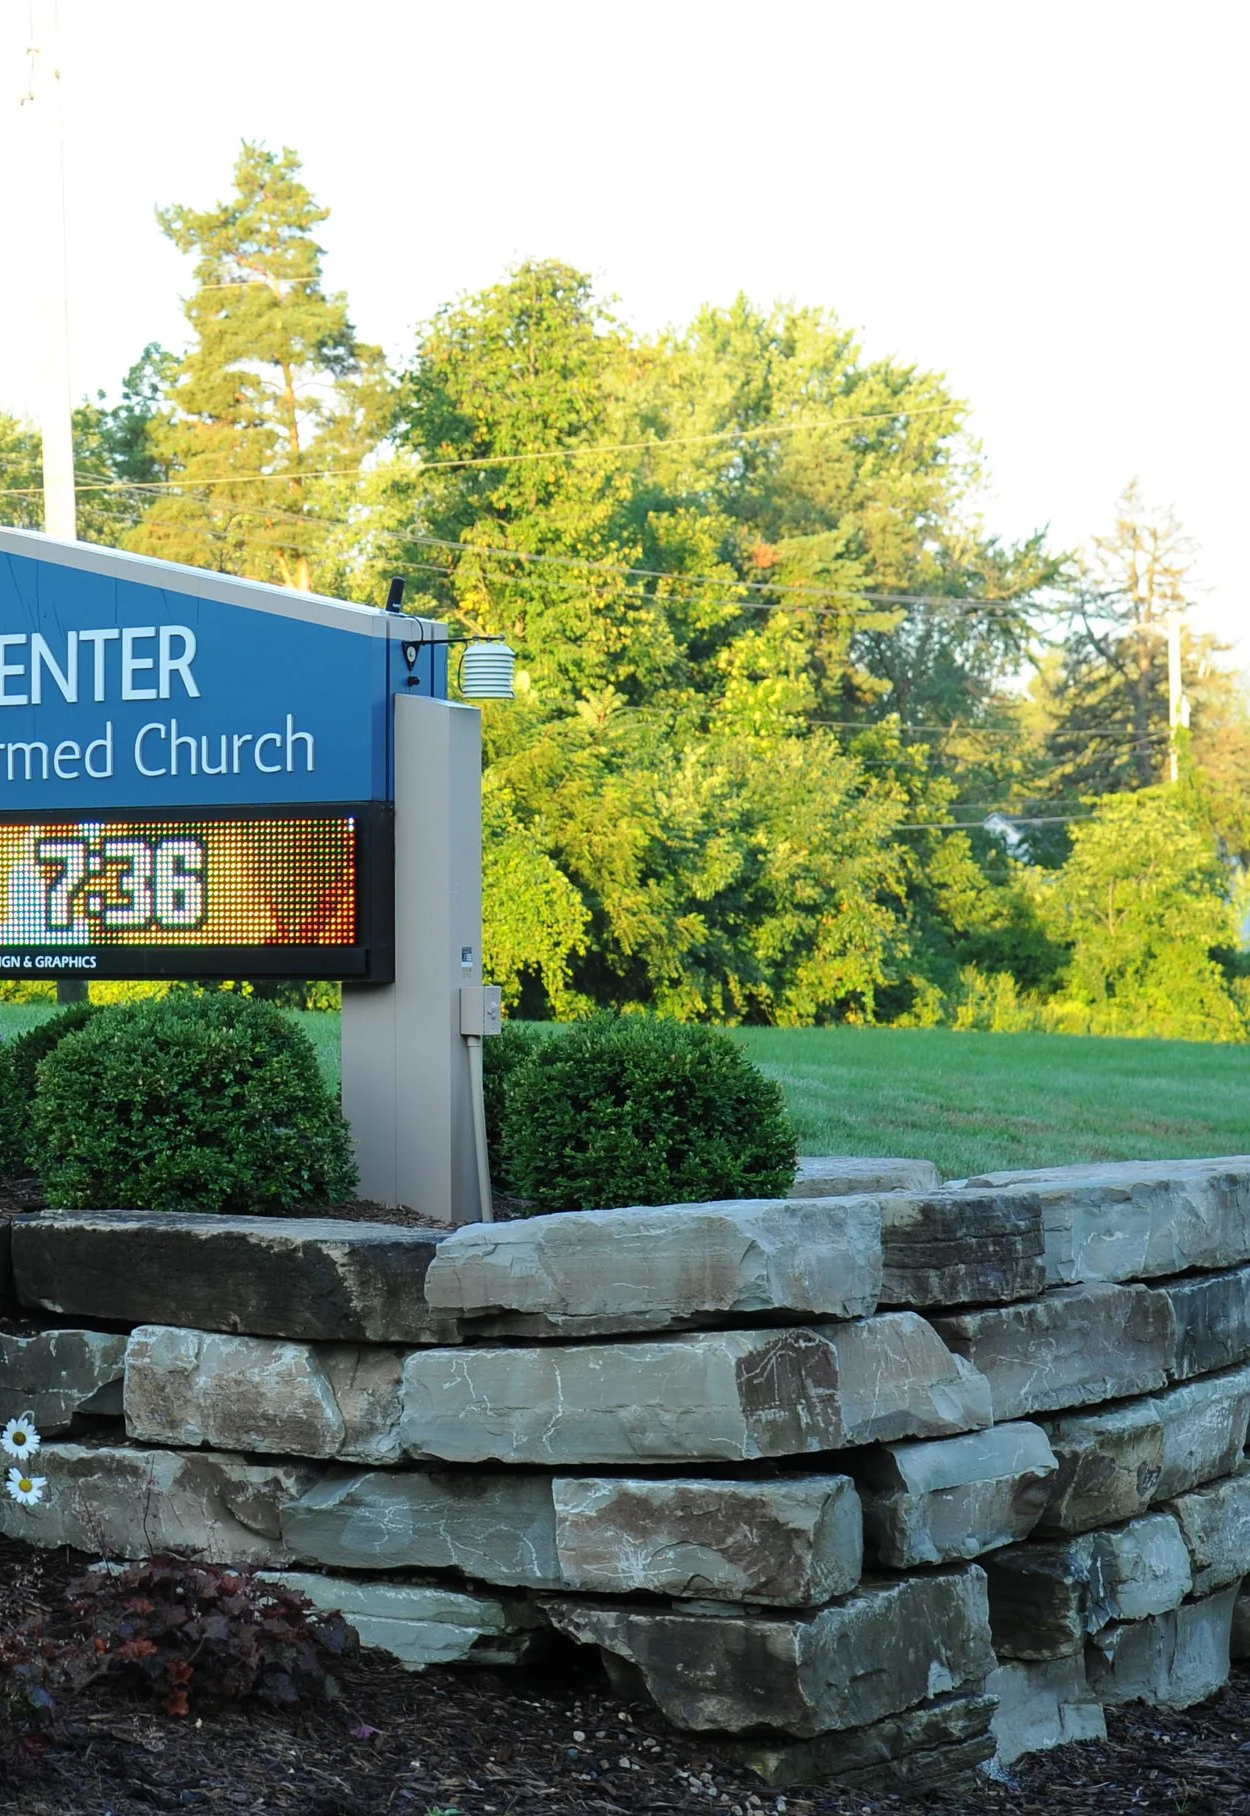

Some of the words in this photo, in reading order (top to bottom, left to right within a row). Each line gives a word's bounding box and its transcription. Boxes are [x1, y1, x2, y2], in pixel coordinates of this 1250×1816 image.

[134, 713, 315, 777] Church
[39, 840, 203, 927] 7:36
[24, 956, 32, 967] &
[36, 955, 97, 968] GRAPHICS
